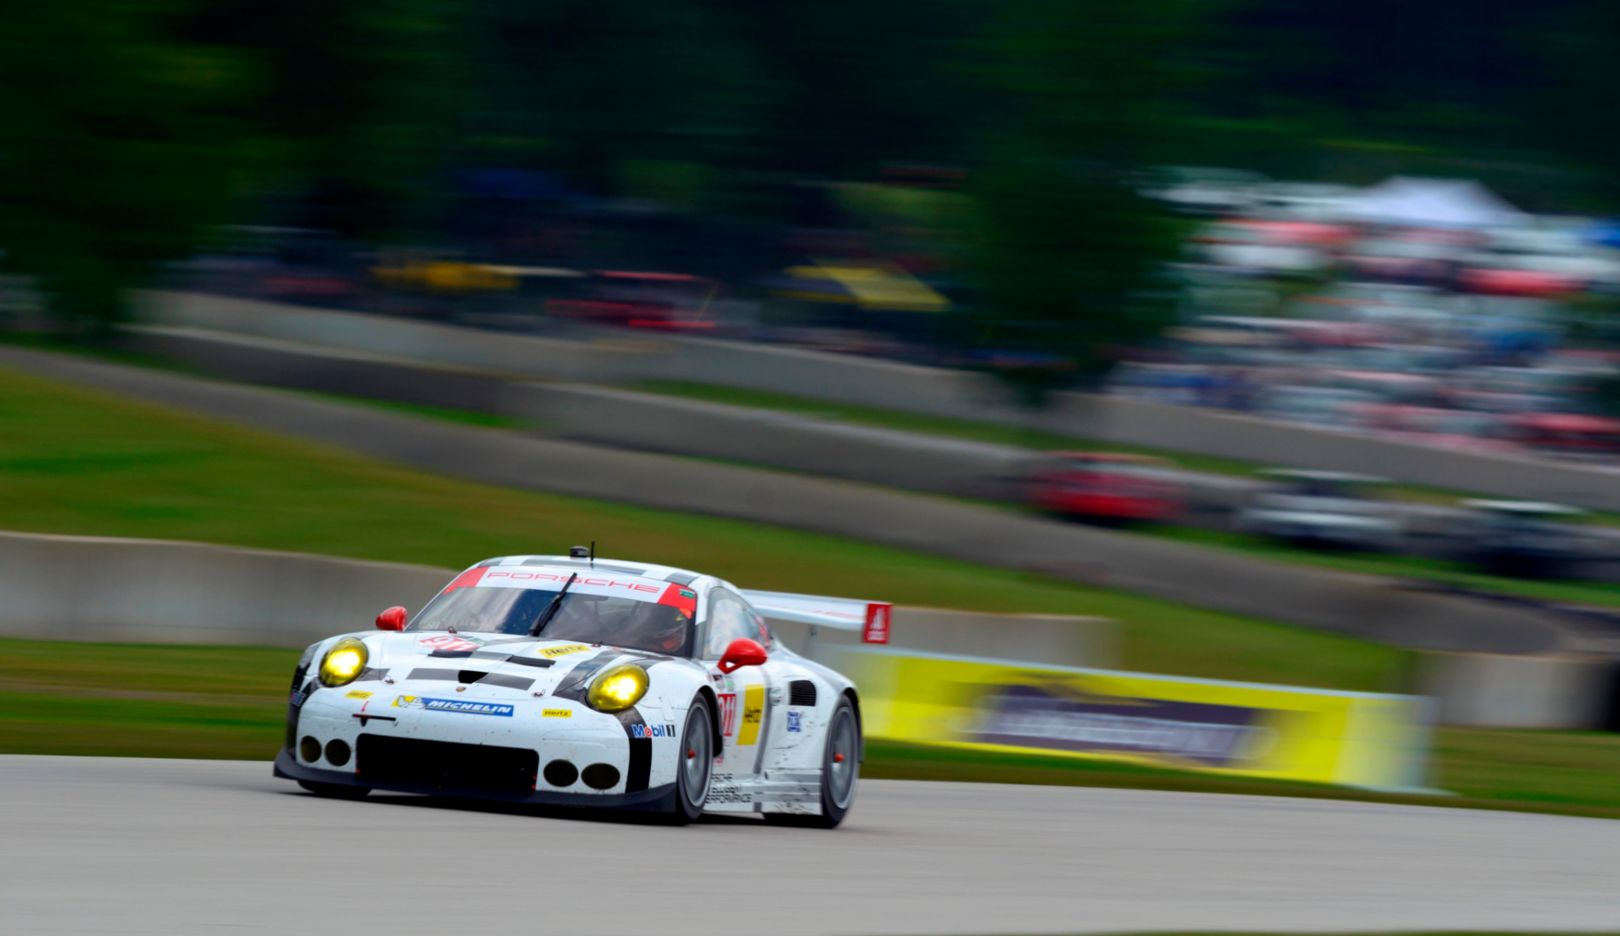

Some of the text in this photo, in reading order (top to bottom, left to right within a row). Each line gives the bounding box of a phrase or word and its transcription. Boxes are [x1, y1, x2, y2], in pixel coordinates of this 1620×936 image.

[487, 572, 660, 594] PORSCHE
[428, 700, 512, 714] MICHELIN
[543, 709, 570, 718] Hertz
[631, 723, 676, 738] Mobil 1
